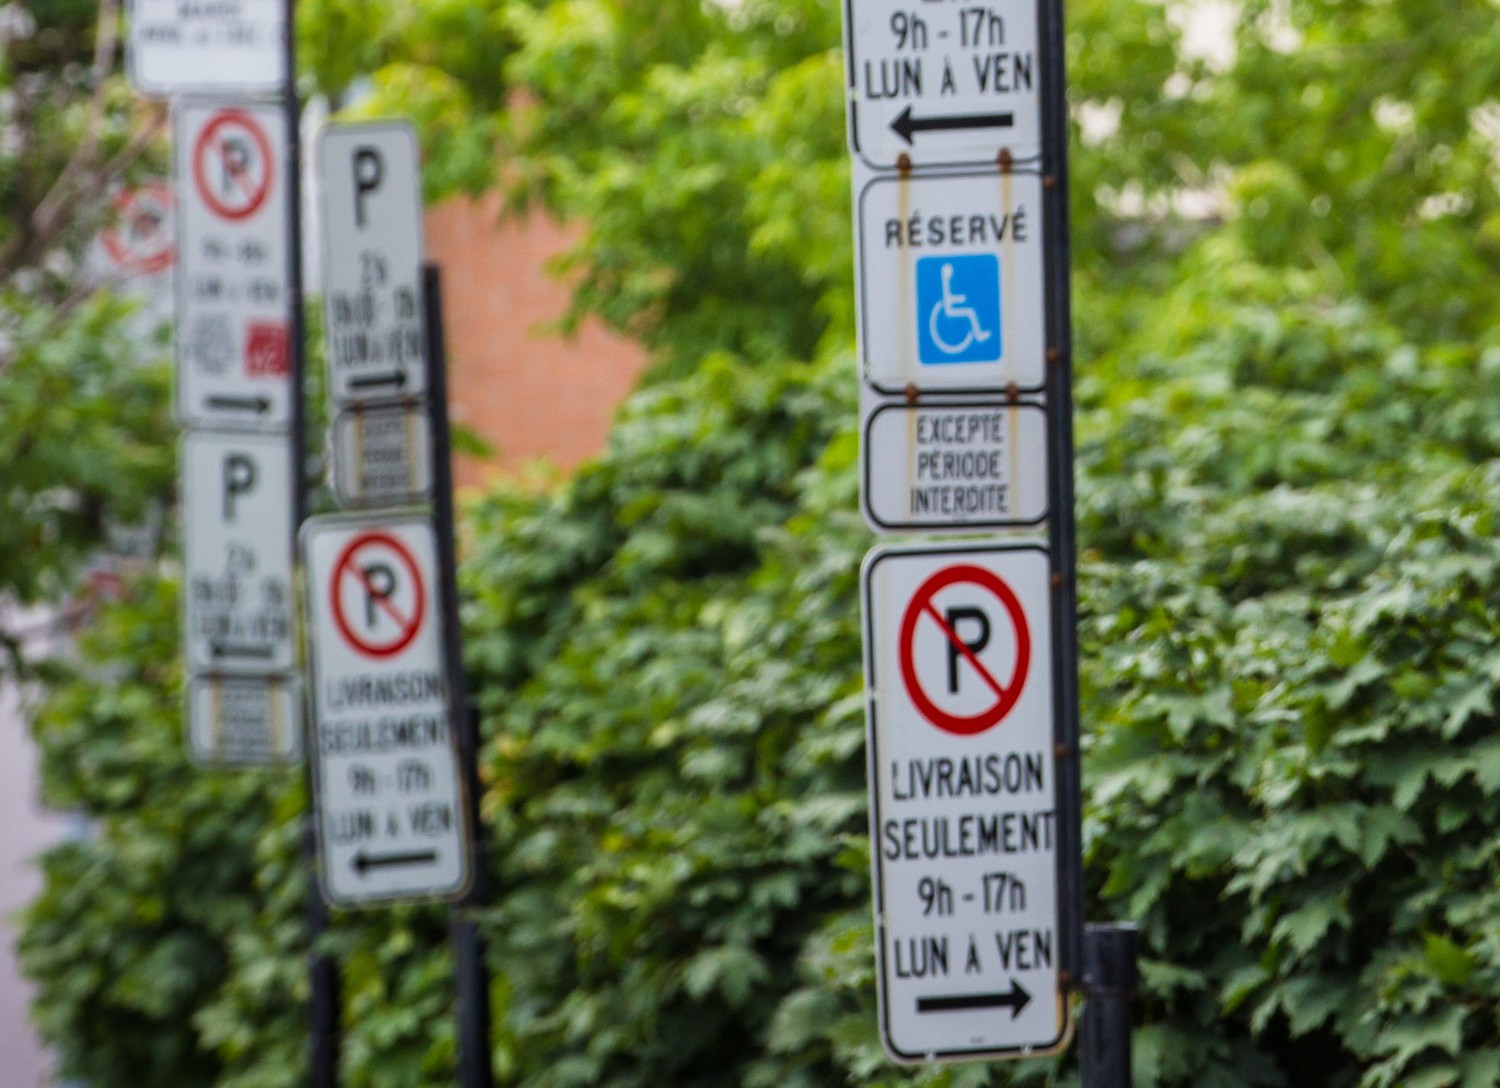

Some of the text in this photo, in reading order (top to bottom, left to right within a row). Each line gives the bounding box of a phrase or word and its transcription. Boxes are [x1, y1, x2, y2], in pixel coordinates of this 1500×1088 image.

[889, 9, 928, 50] 9h
[959, 8, 1005, 47] 17h
[864, 58, 923, 100] LUN
[973, 52, 1033, 94] VEN
[886, 204, 1028, 249] RÉSERVÉ
[916, 410, 1004, 445] EXCEPTÉ
[917, 447, 1002, 480] PÉRIODE
[910, 484, 1009, 514] INTERDITE
[944, 604, 991, 695] P
[892, 751, 1044, 801] LIVRAISON
[884, 809, 1055, 861] SEULEMENT
[918, 874, 954, 917] 9h
[982, 871, 1026, 912] 17h
[895, 935, 949, 979] LUN
[996, 928, 1052, 970] VEN
